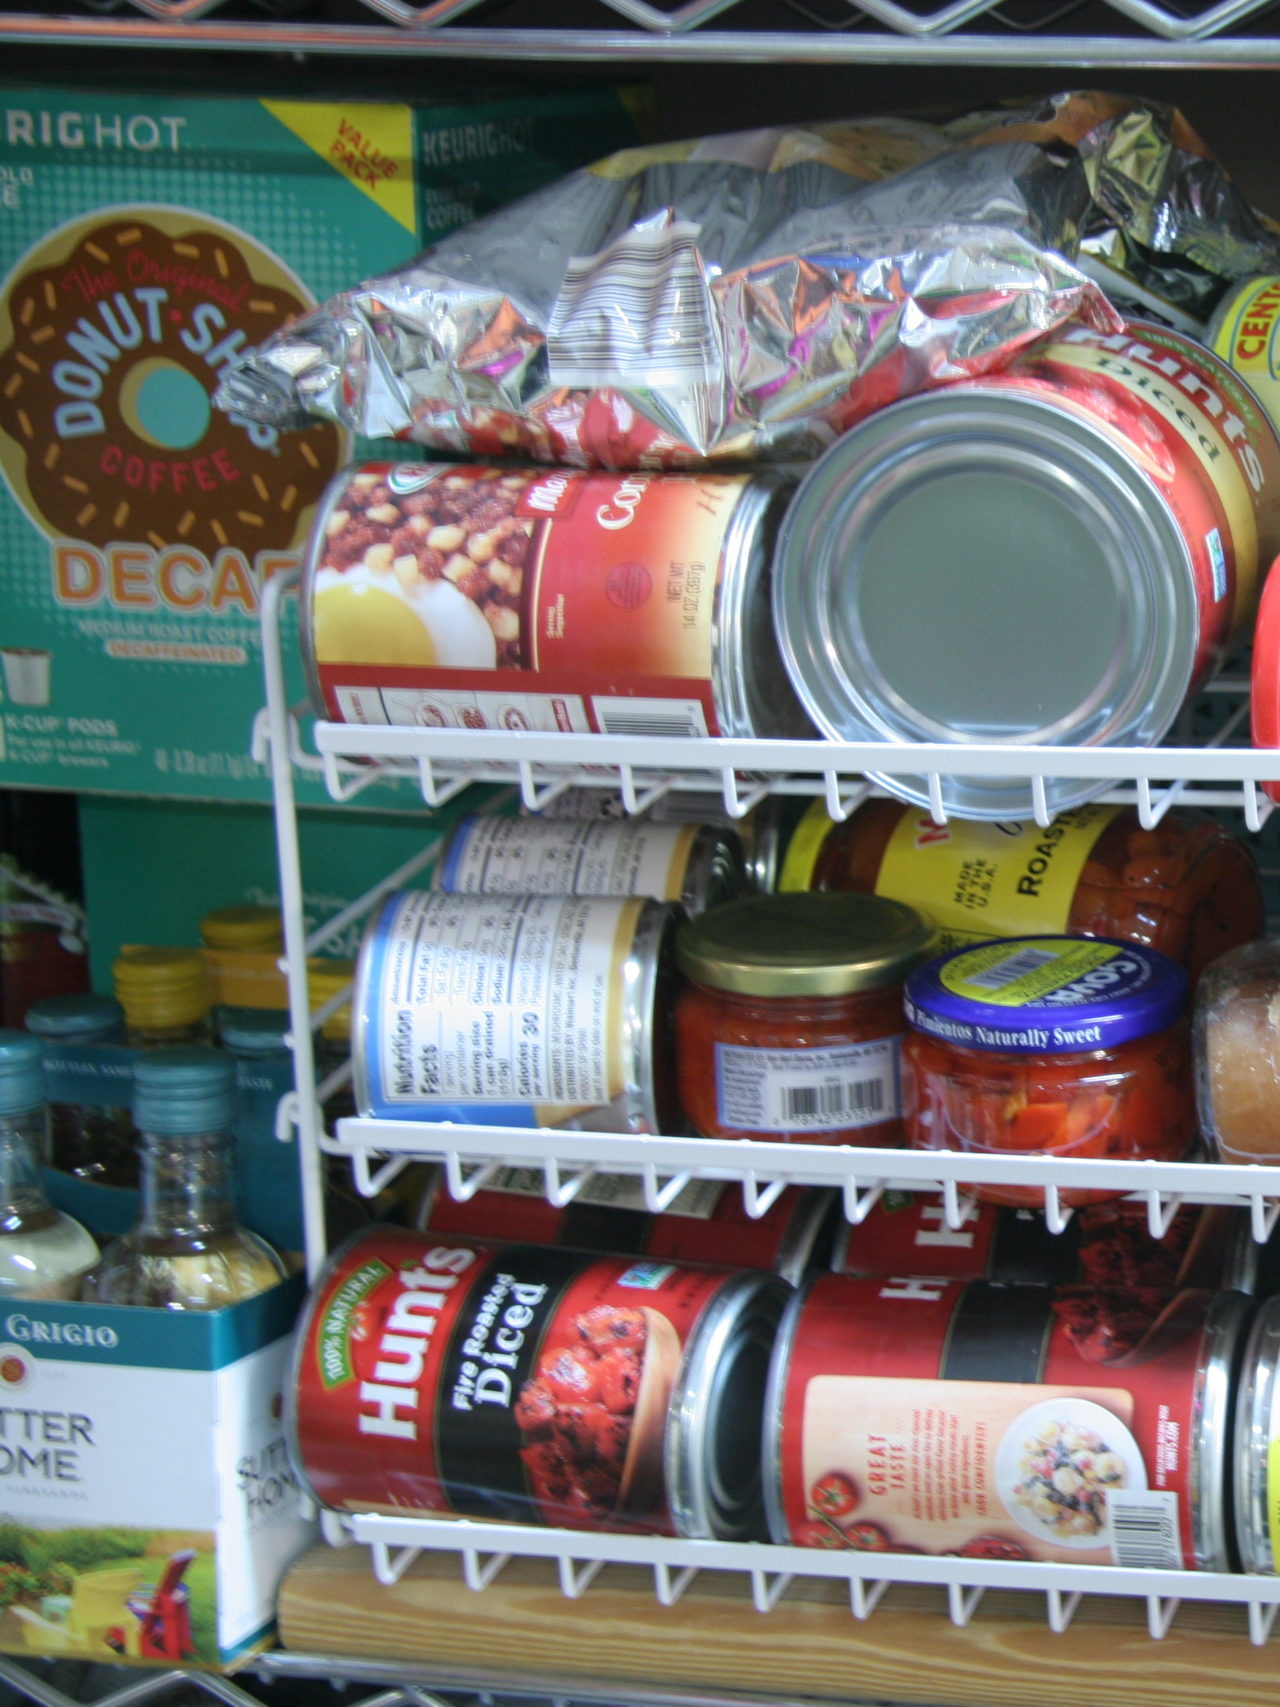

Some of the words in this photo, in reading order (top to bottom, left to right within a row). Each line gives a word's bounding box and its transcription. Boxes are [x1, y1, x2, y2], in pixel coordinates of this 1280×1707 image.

[95, 114, 187, 151] HOT
[337, 117, 398, 180] VALUE
[330, 140, 380, 191] PACK
[52, 287, 168, 440] DONUT
[180, 302, 281, 457] SHP
[100, 446, 240, 494] COFFEE
[953, 861, 974, 904] MADE
[974, 1025, 1051, 1049] Naturally
[1053, 1024, 1102, 1047] Sweet
[418, 1044, 440, 1094] Facts
[325, 1265, 386, 1334] NATURAL
[462, 1272, 517, 1358] Roasted
[6, 1313, 119, 1348] GRIGIO
[474, 1282, 549, 1409] Diced
[324, 1335, 345, 1381] 100%
[452, 1360, 480, 1411] Fire
[867, 1434, 889, 1496] GREAT
[890, 1444, 906, 1489] TASTE
